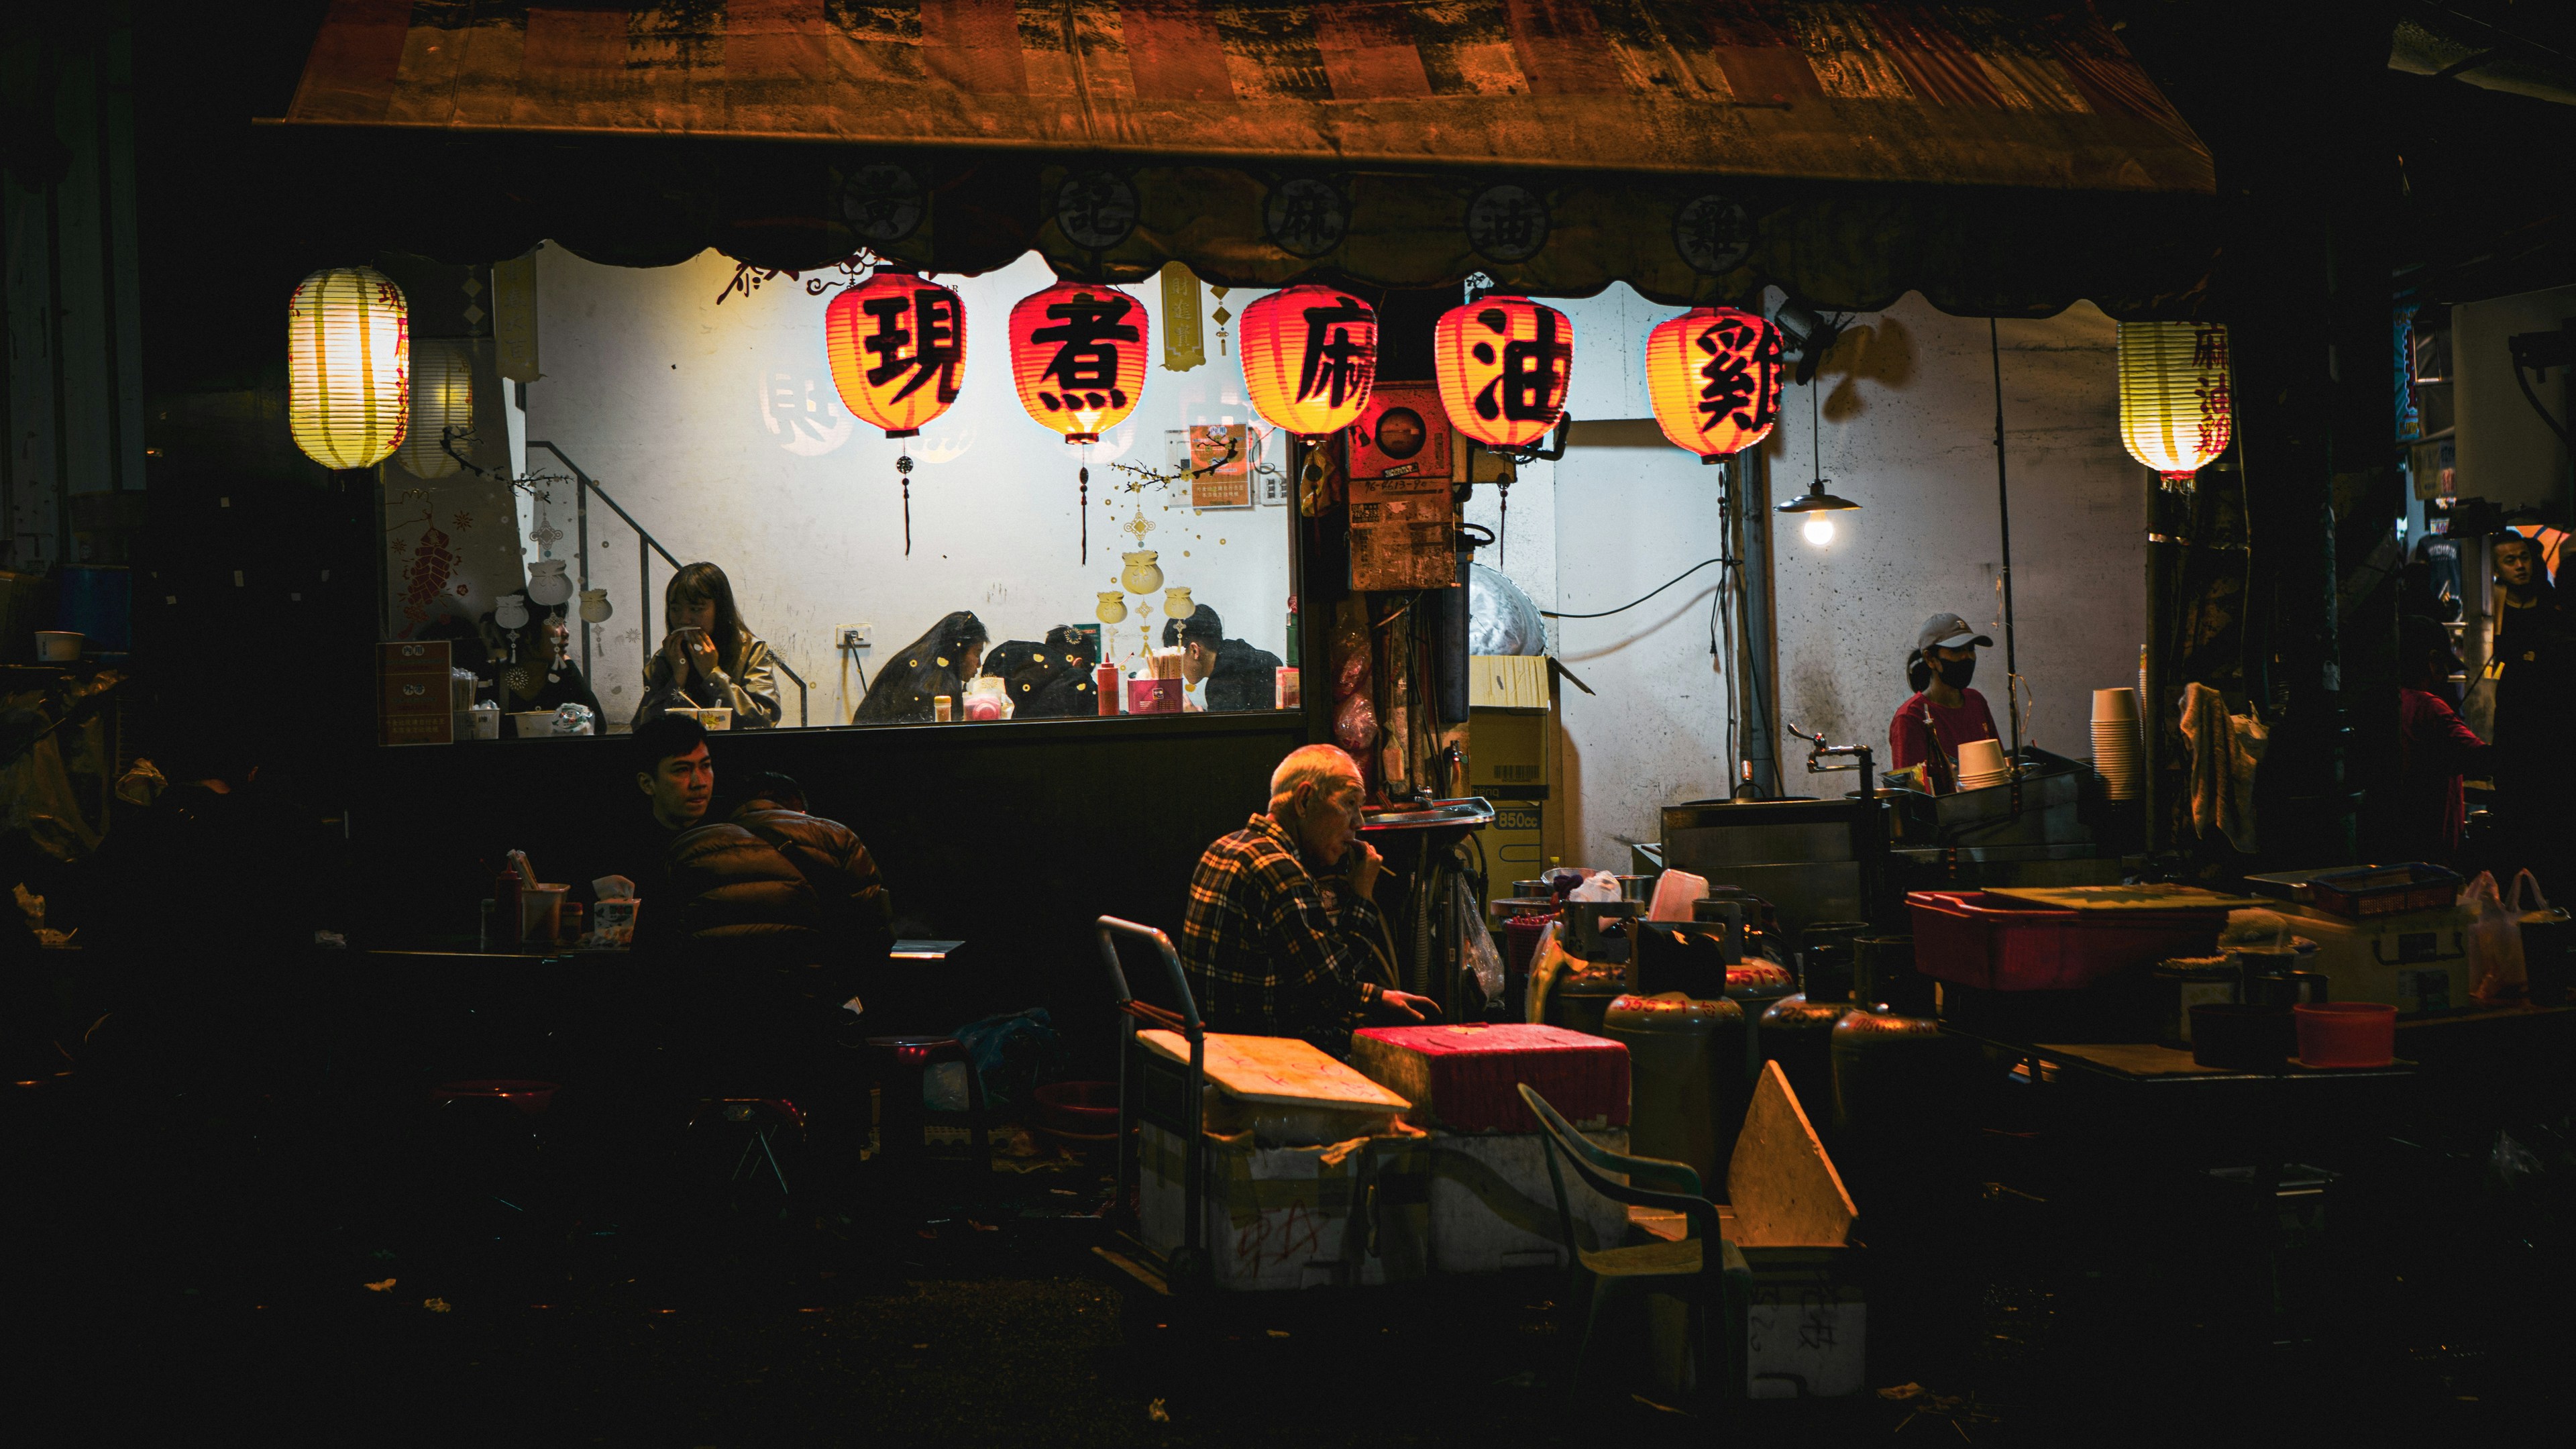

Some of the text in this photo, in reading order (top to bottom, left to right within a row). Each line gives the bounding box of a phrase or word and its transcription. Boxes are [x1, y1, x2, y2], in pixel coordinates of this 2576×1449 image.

[863, 289, 962, 405] 現
[1030, 292, 1140, 412] 煮
[1474, 307, 1571, 422] 油
[1499, 812, 1538, 828] 850cc
